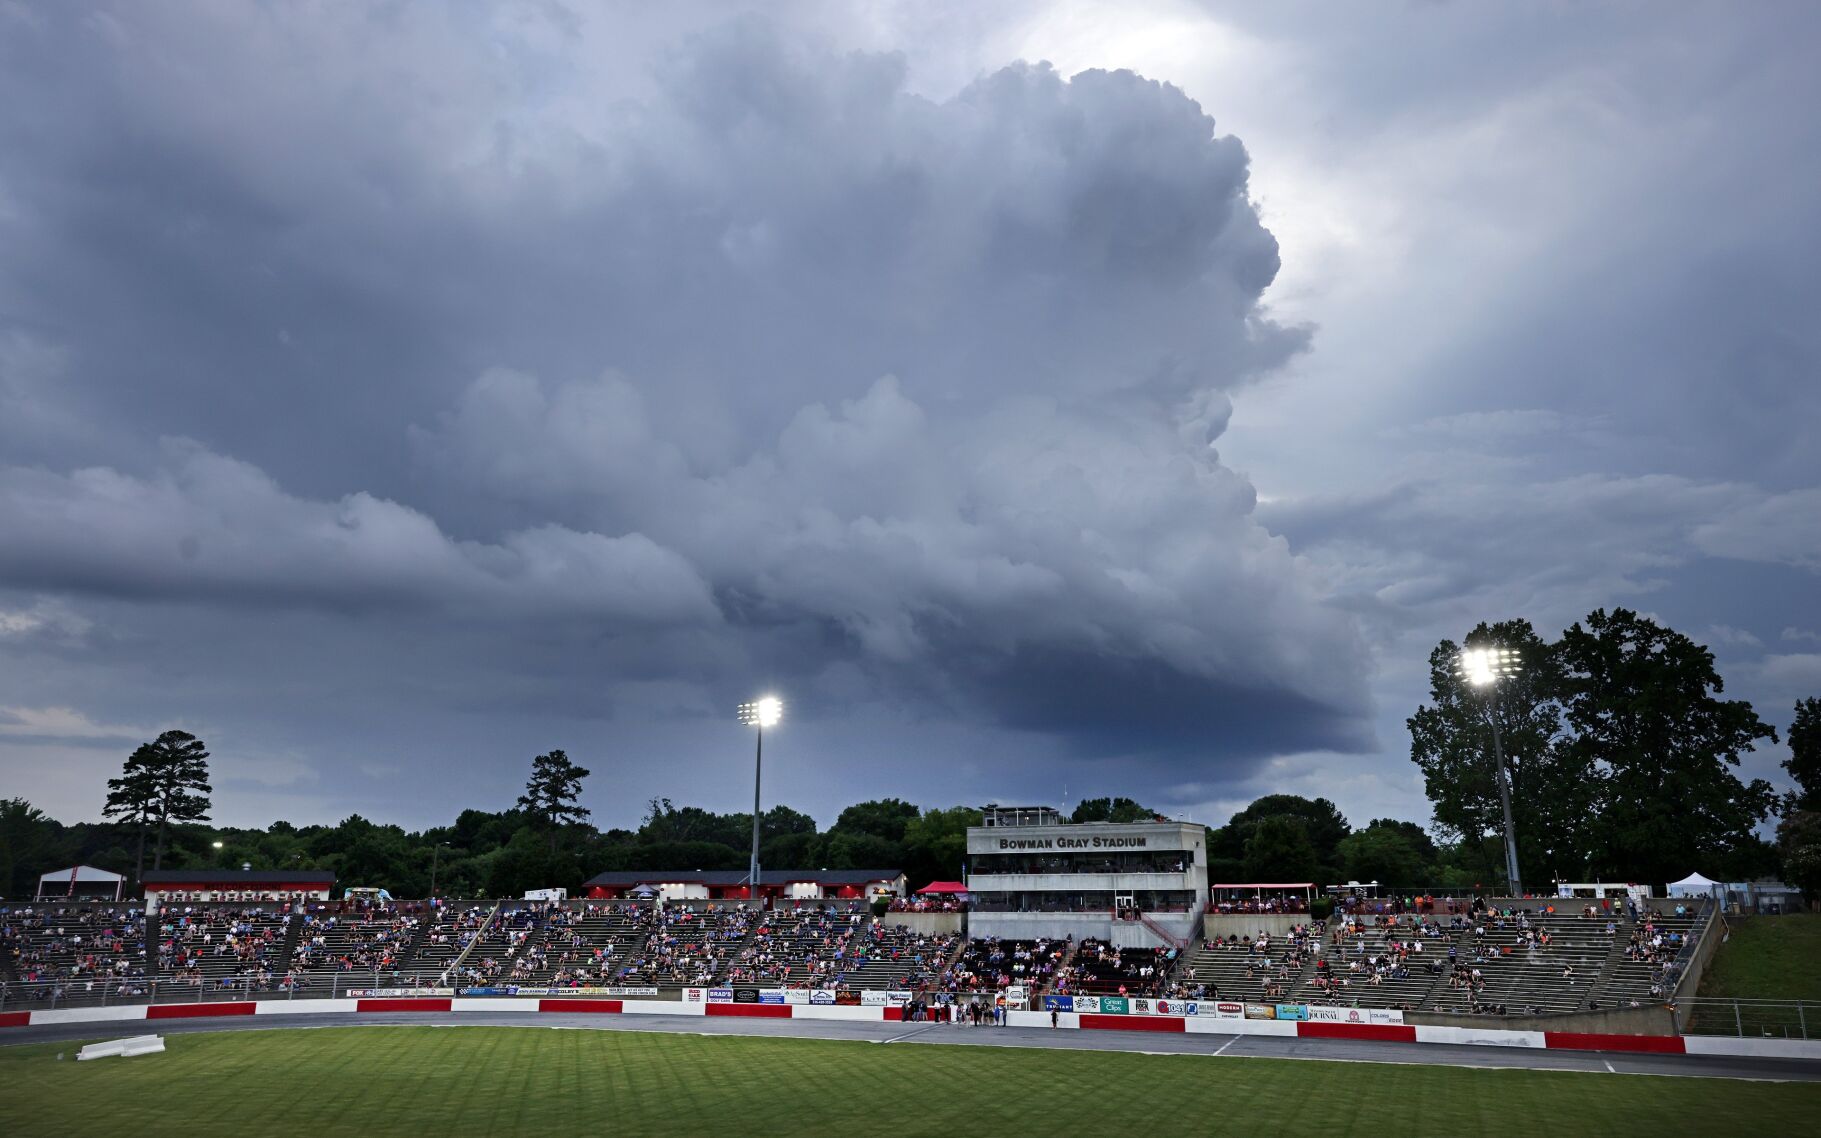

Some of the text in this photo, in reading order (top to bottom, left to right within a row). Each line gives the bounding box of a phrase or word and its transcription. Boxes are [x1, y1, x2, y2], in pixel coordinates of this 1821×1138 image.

[1000, 836, 1146, 849] BOWMAN GRAY STADIUM
